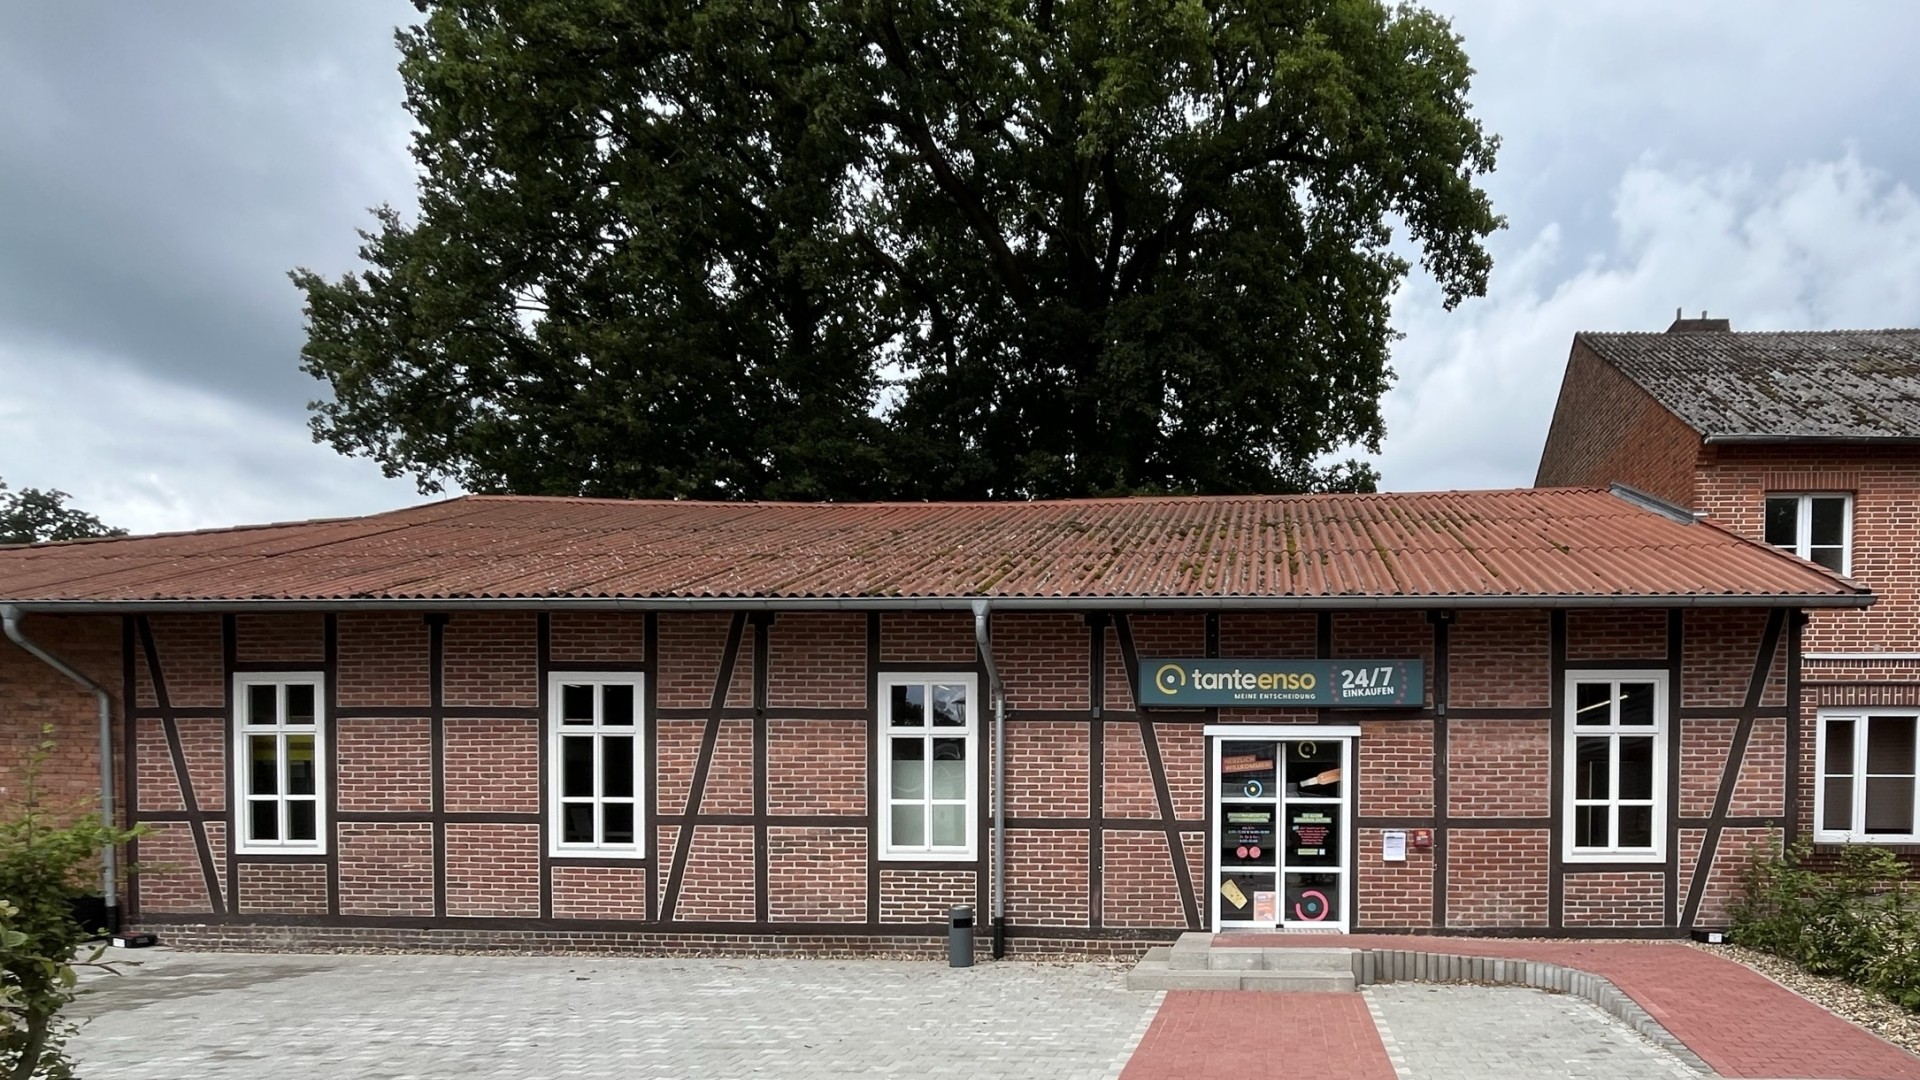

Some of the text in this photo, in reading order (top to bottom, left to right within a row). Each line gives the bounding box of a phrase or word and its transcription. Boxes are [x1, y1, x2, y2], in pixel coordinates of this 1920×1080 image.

[1192, 669, 1316, 690] tanteenso
[1341, 667, 1393, 689] 24/7
[1342, 686, 1394, 698] EINKAUFEN
